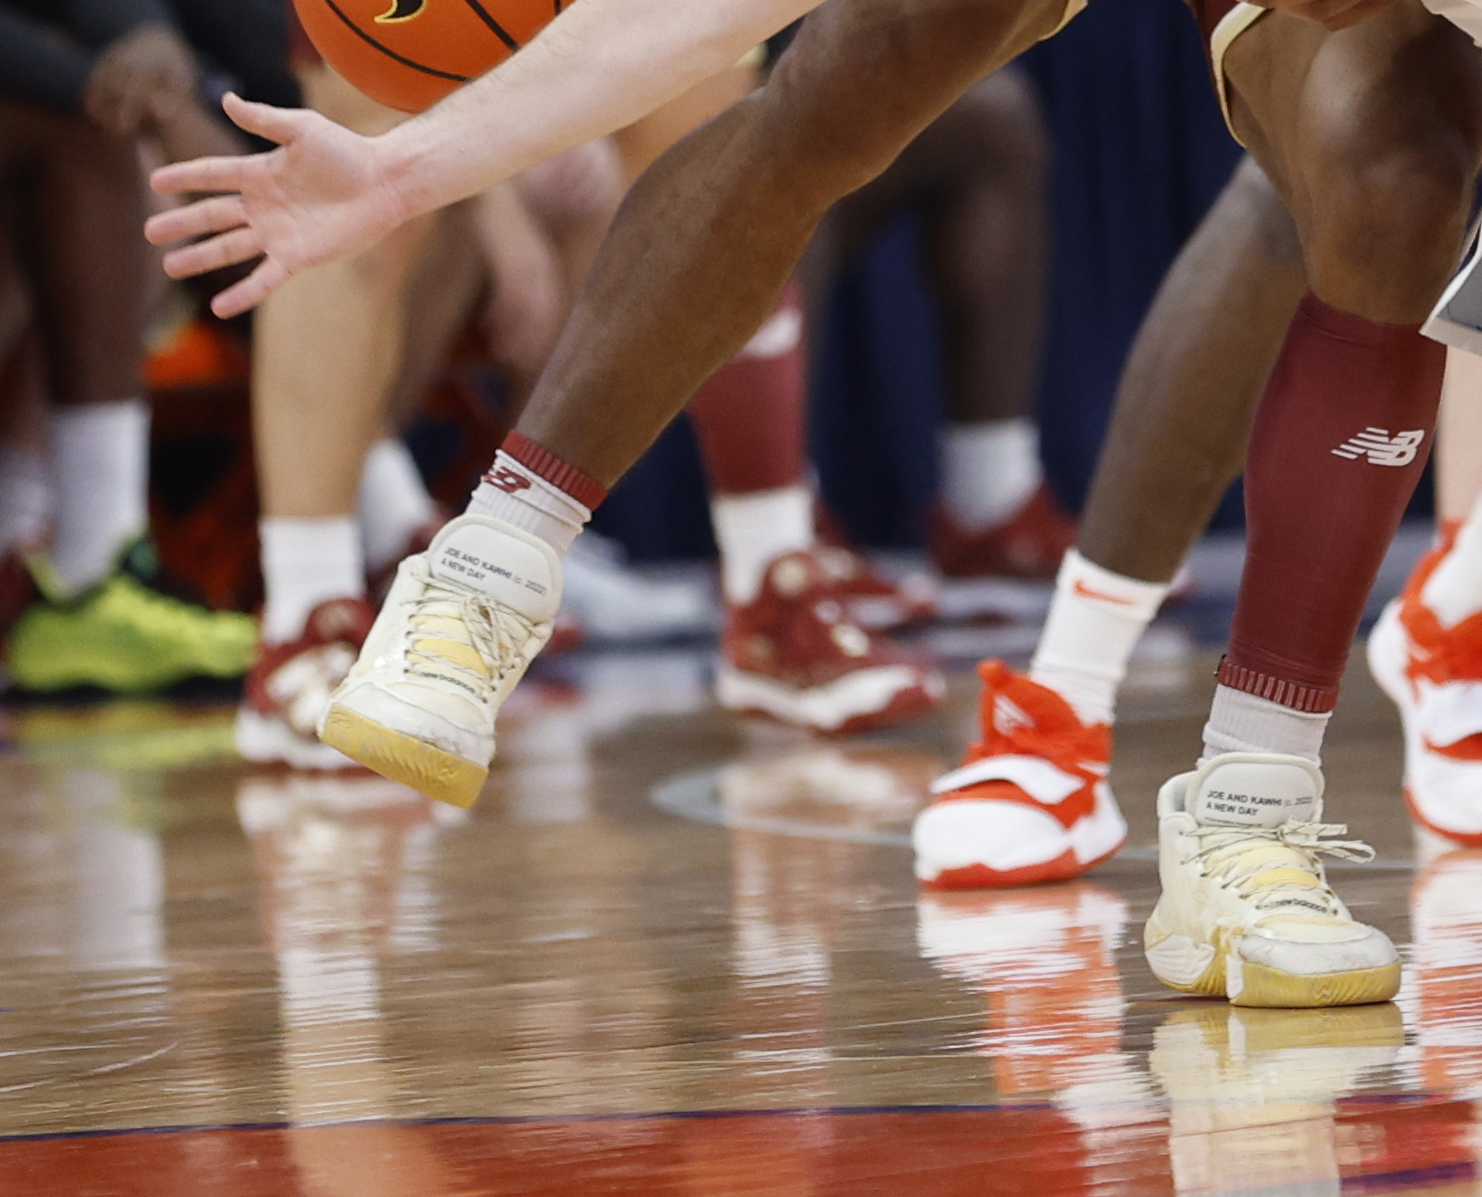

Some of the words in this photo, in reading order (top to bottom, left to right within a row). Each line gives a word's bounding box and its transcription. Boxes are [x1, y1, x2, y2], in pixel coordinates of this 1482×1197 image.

[444, 547, 461, 559] JOE
[461, 553, 480, 566] AND
[447, 561, 466, 573] NEW
[466, 568, 486, 580] DAY
[1207, 790, 1225, 801] JOE
[1226, 793, 1249, 803] AND
[1250, 796, 1283, 807] KAWHI
[1206, 801, 1213, 809] A
[1213, 803, 1236, 813] NEW
[1238, 806, 1259, 816] DAY
